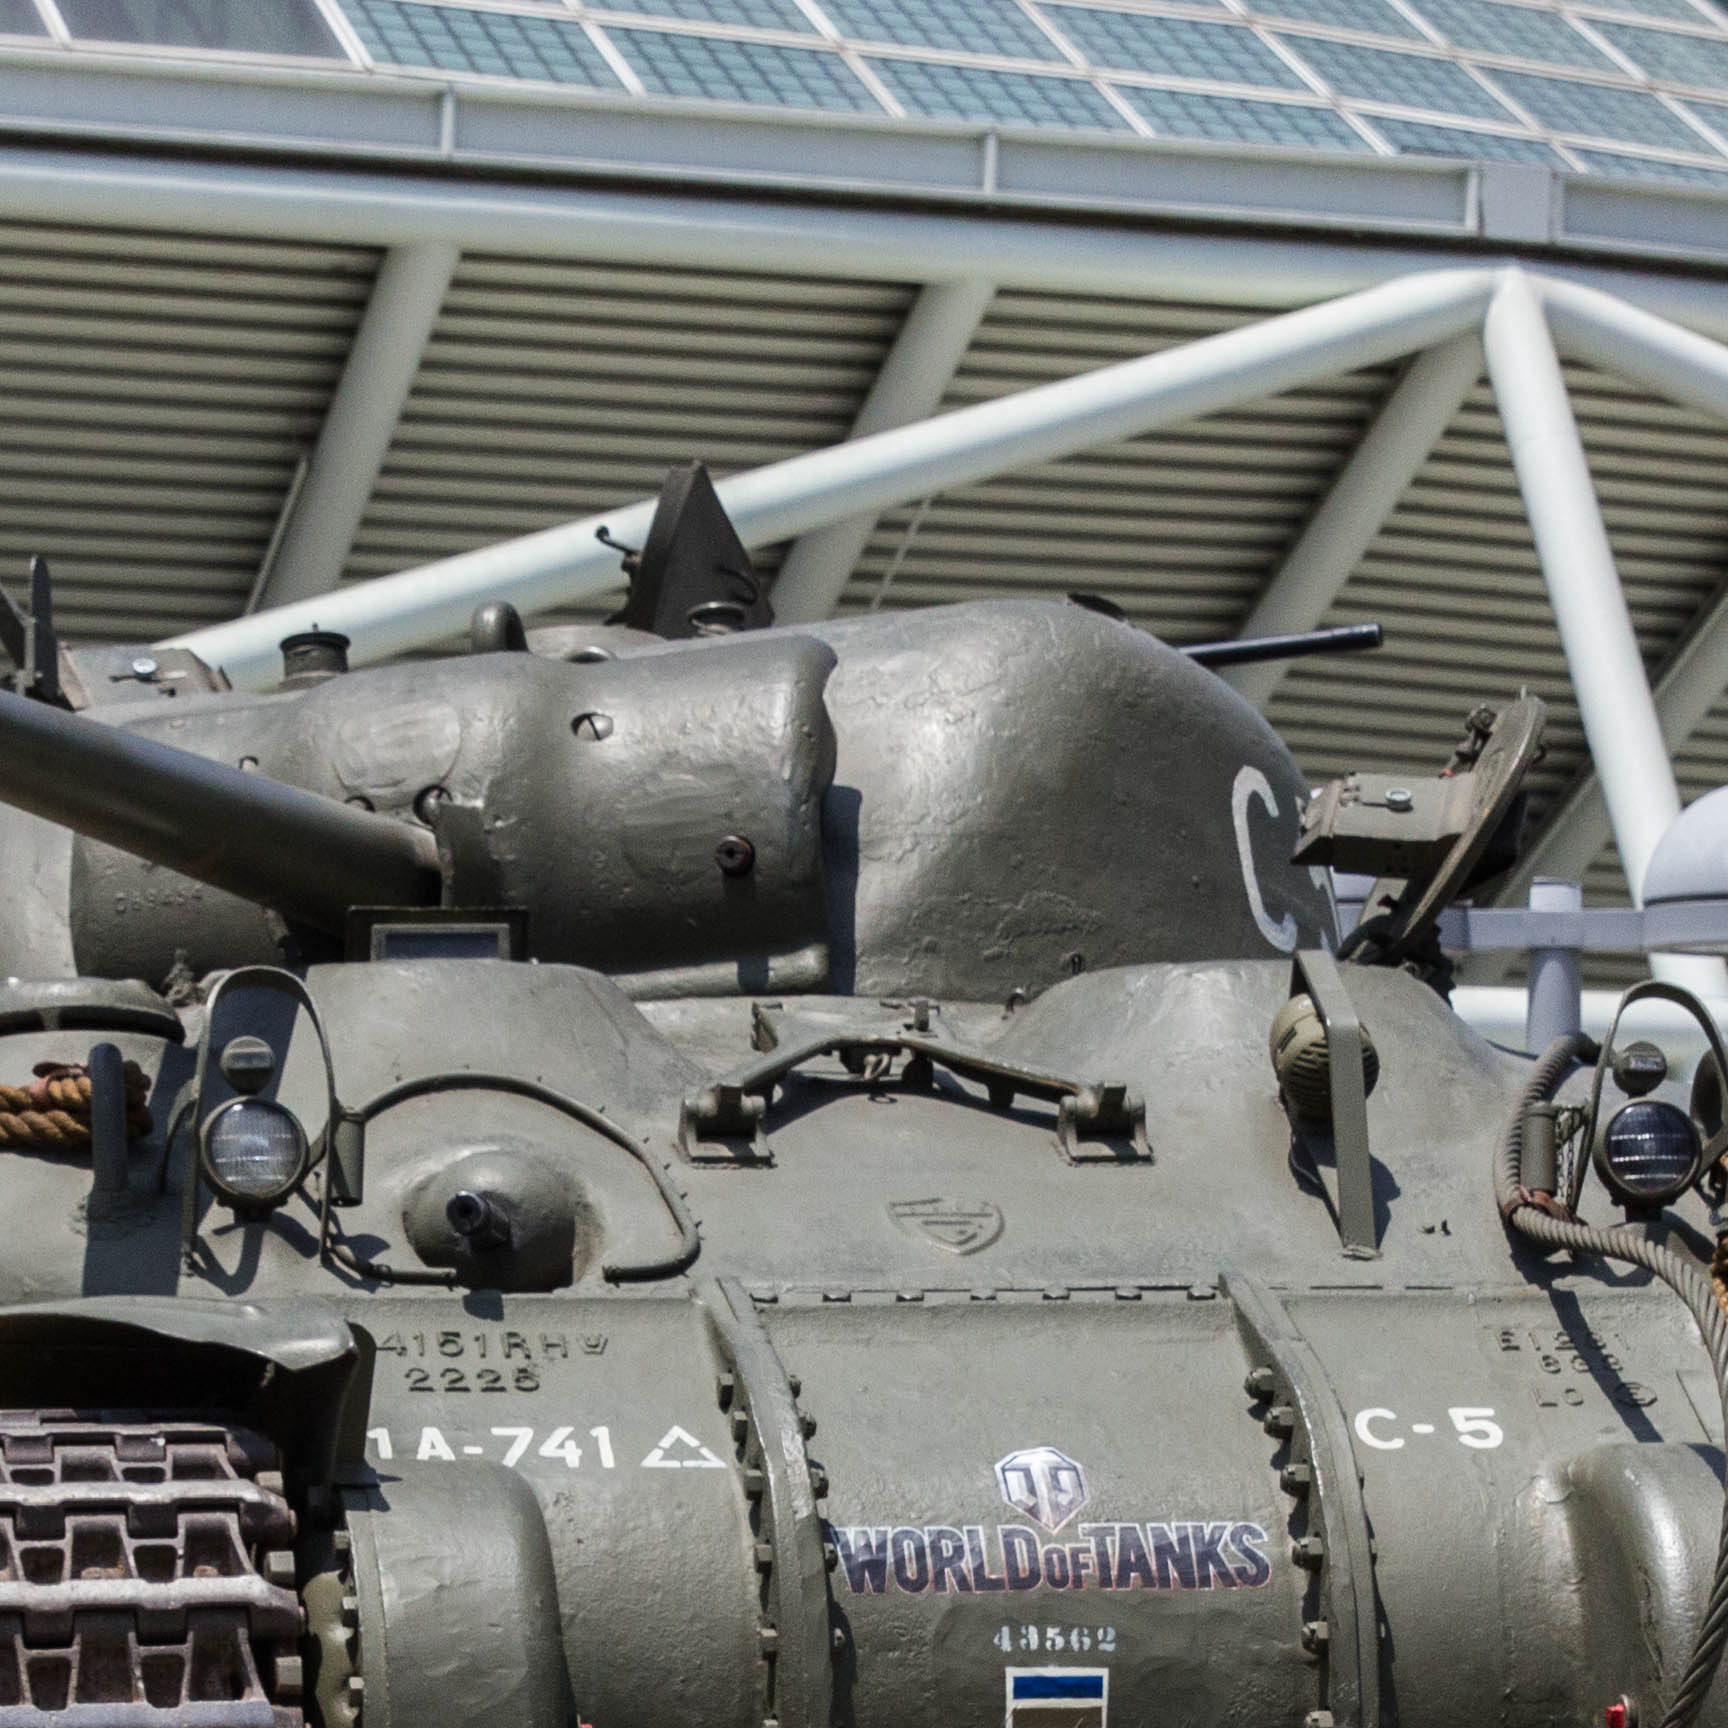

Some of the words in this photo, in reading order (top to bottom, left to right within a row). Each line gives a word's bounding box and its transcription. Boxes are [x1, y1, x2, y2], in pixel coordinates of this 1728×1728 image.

[1353, 1406, 1504, 1450] C-5
[834, 1524, 1042, 1594] WORLD
[1040, 1543, 1091, 1591] OF
[1078, 1520, 1271, 1592] TANKS
